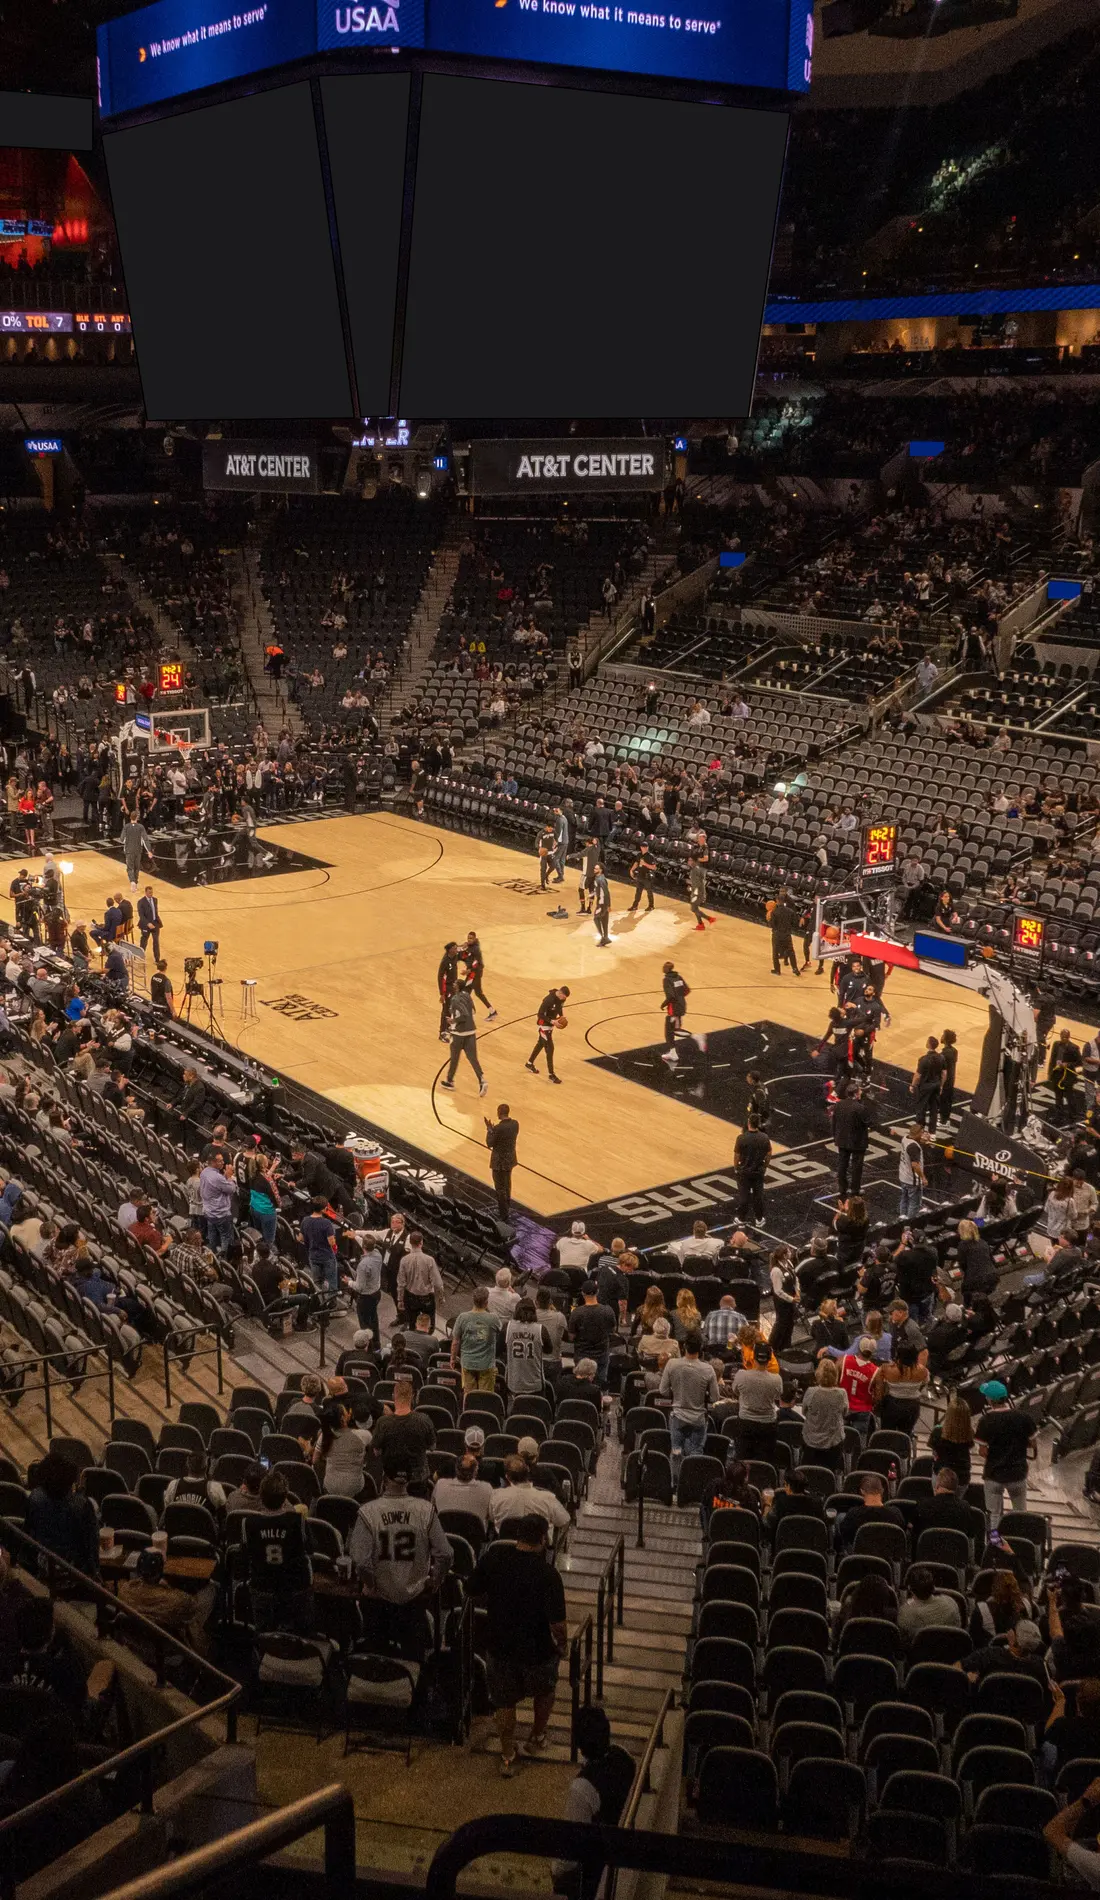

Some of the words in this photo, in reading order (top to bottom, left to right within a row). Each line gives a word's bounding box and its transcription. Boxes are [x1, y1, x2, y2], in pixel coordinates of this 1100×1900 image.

[335, 7, 400, 34] USAA
[542, 0, 576, 16] know
[580, 4, 609, 20] what
[614, 7, 623, 22] it
[627, 11, 665, 27] means
[669, 14, 681, 29] to
[150, 42, 161, 58] We
[162, 37, 180, 53] know
[182, 29, 199, 46] what
[201, 26, 206, 40] it
[208, 19, 231, 37] means
[233, 15, 241, 29] to
[25, 315, 49, 328] TOL
[56, 316, 64, 327] 7
[80, 322, 87, 331] 0
[97, 322, 104, 331] 0
[114, 322, 121, 331] 0
[38, 442, 58, 450] USAA
[226, 454, 256, 476] AT&T
[258, 454, 310, 478] CENTER
[516, 455, 570, 478] AT&T
[573, 454, 654, 477] CENTER
[162, 674, 179, 688] 24
[870, 826, 894, 840] 14:21
[869, 841, 890, 862] 24
[1021, 930, 1037, 944] 24
[512, 1341, 535, 1359] 21
[381, 1511, 411, 1526] BOWEN
[260, 1528, 287, 1539] MILLS
[378, 1530, 416, 1561] 12
